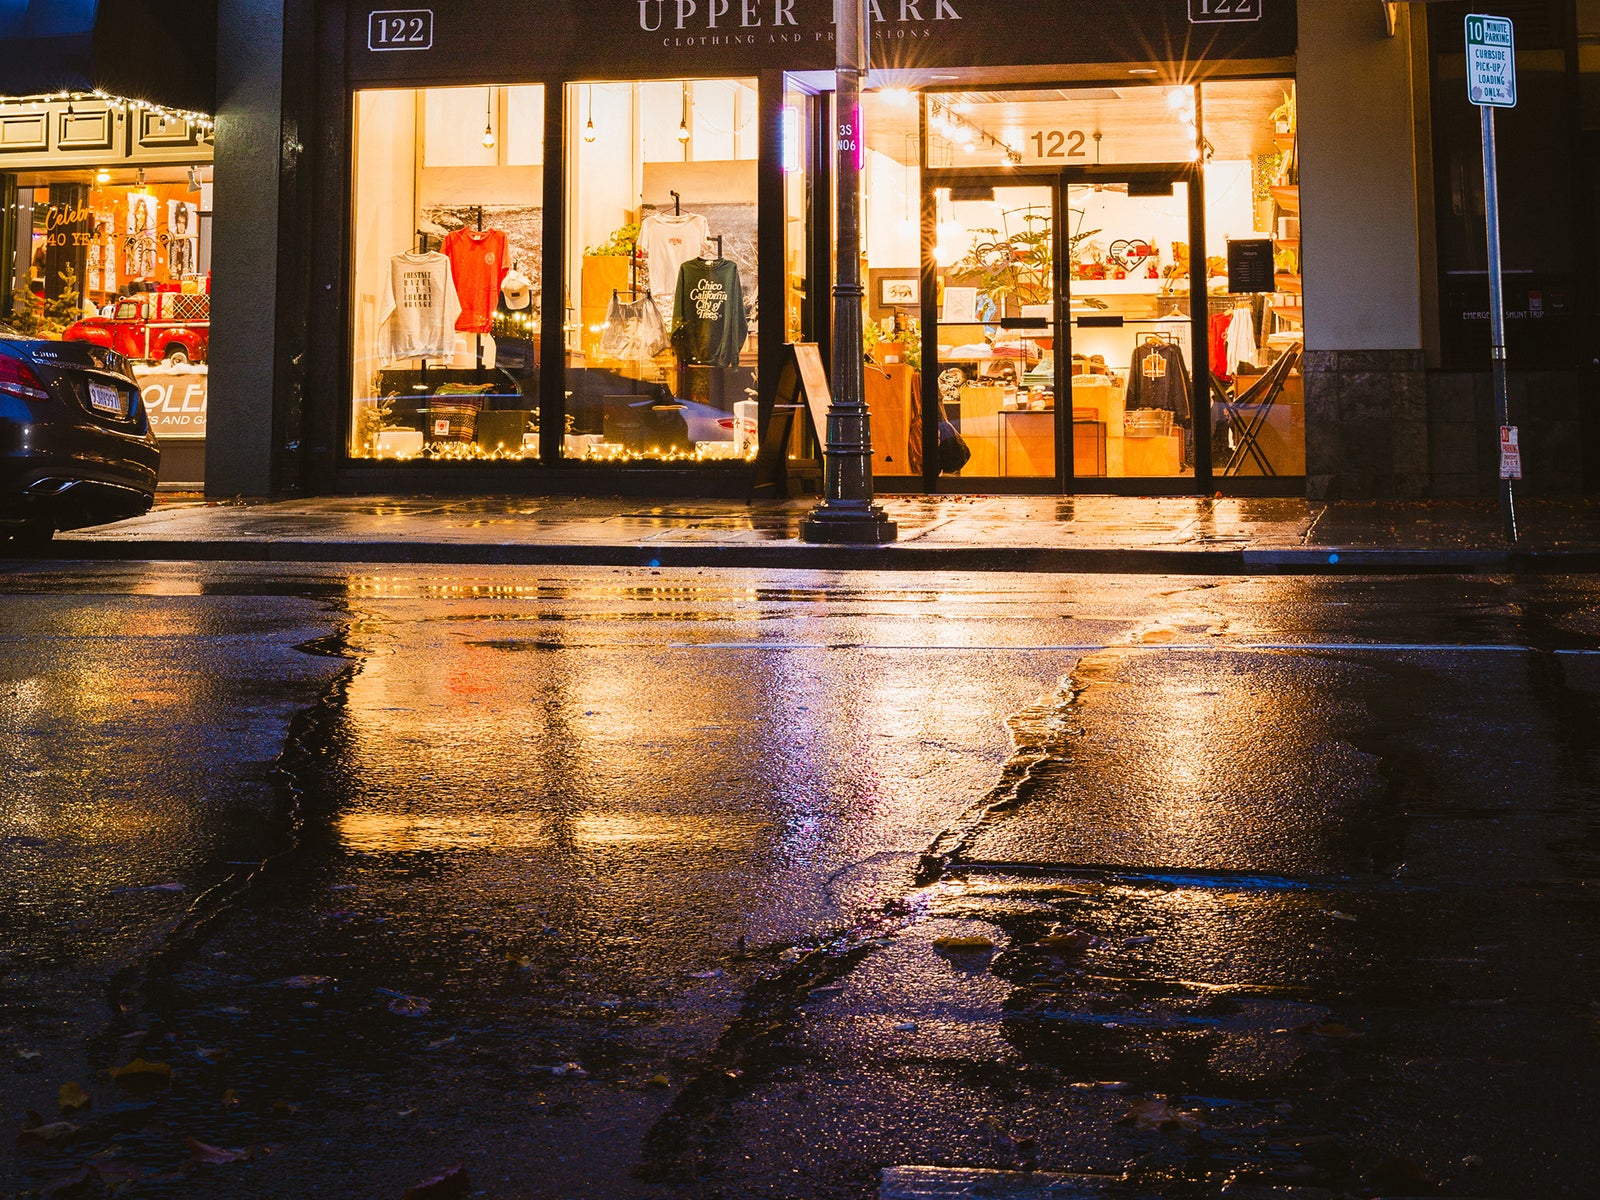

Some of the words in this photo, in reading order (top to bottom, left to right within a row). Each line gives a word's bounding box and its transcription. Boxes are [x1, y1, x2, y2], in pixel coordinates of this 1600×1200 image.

[378, 17, 424, 43] 122
[1469, 22, 1483, 41] 10
[1486, 22, 1507, 34] MINUTE
[663, 34, 755, 47] CLOTHING
[768, 32, 802, 44] AND
[815, 28, 931, 42] PRSIONS
[1485, 31, 1509, 44] PARKING
[1475, 48, 1506, 61] CURBSIDE
[1478, 74, 1505, 86] LOADING
[1484, 87, 1501, 98] ONLY
[1031, 130, 1085, 157] 122
[47, 233, 66, 247] 40
[697, 278, 723, 291] Chico
[689, 288, 728, 301] California
[695, 299, 712, 311] City
[712, 299, 724, 312] of
[696, 309, 719, 321] Trees
[1462, 311, 1491, 320] EMERGE
[161, 415, 191, 425] AND
